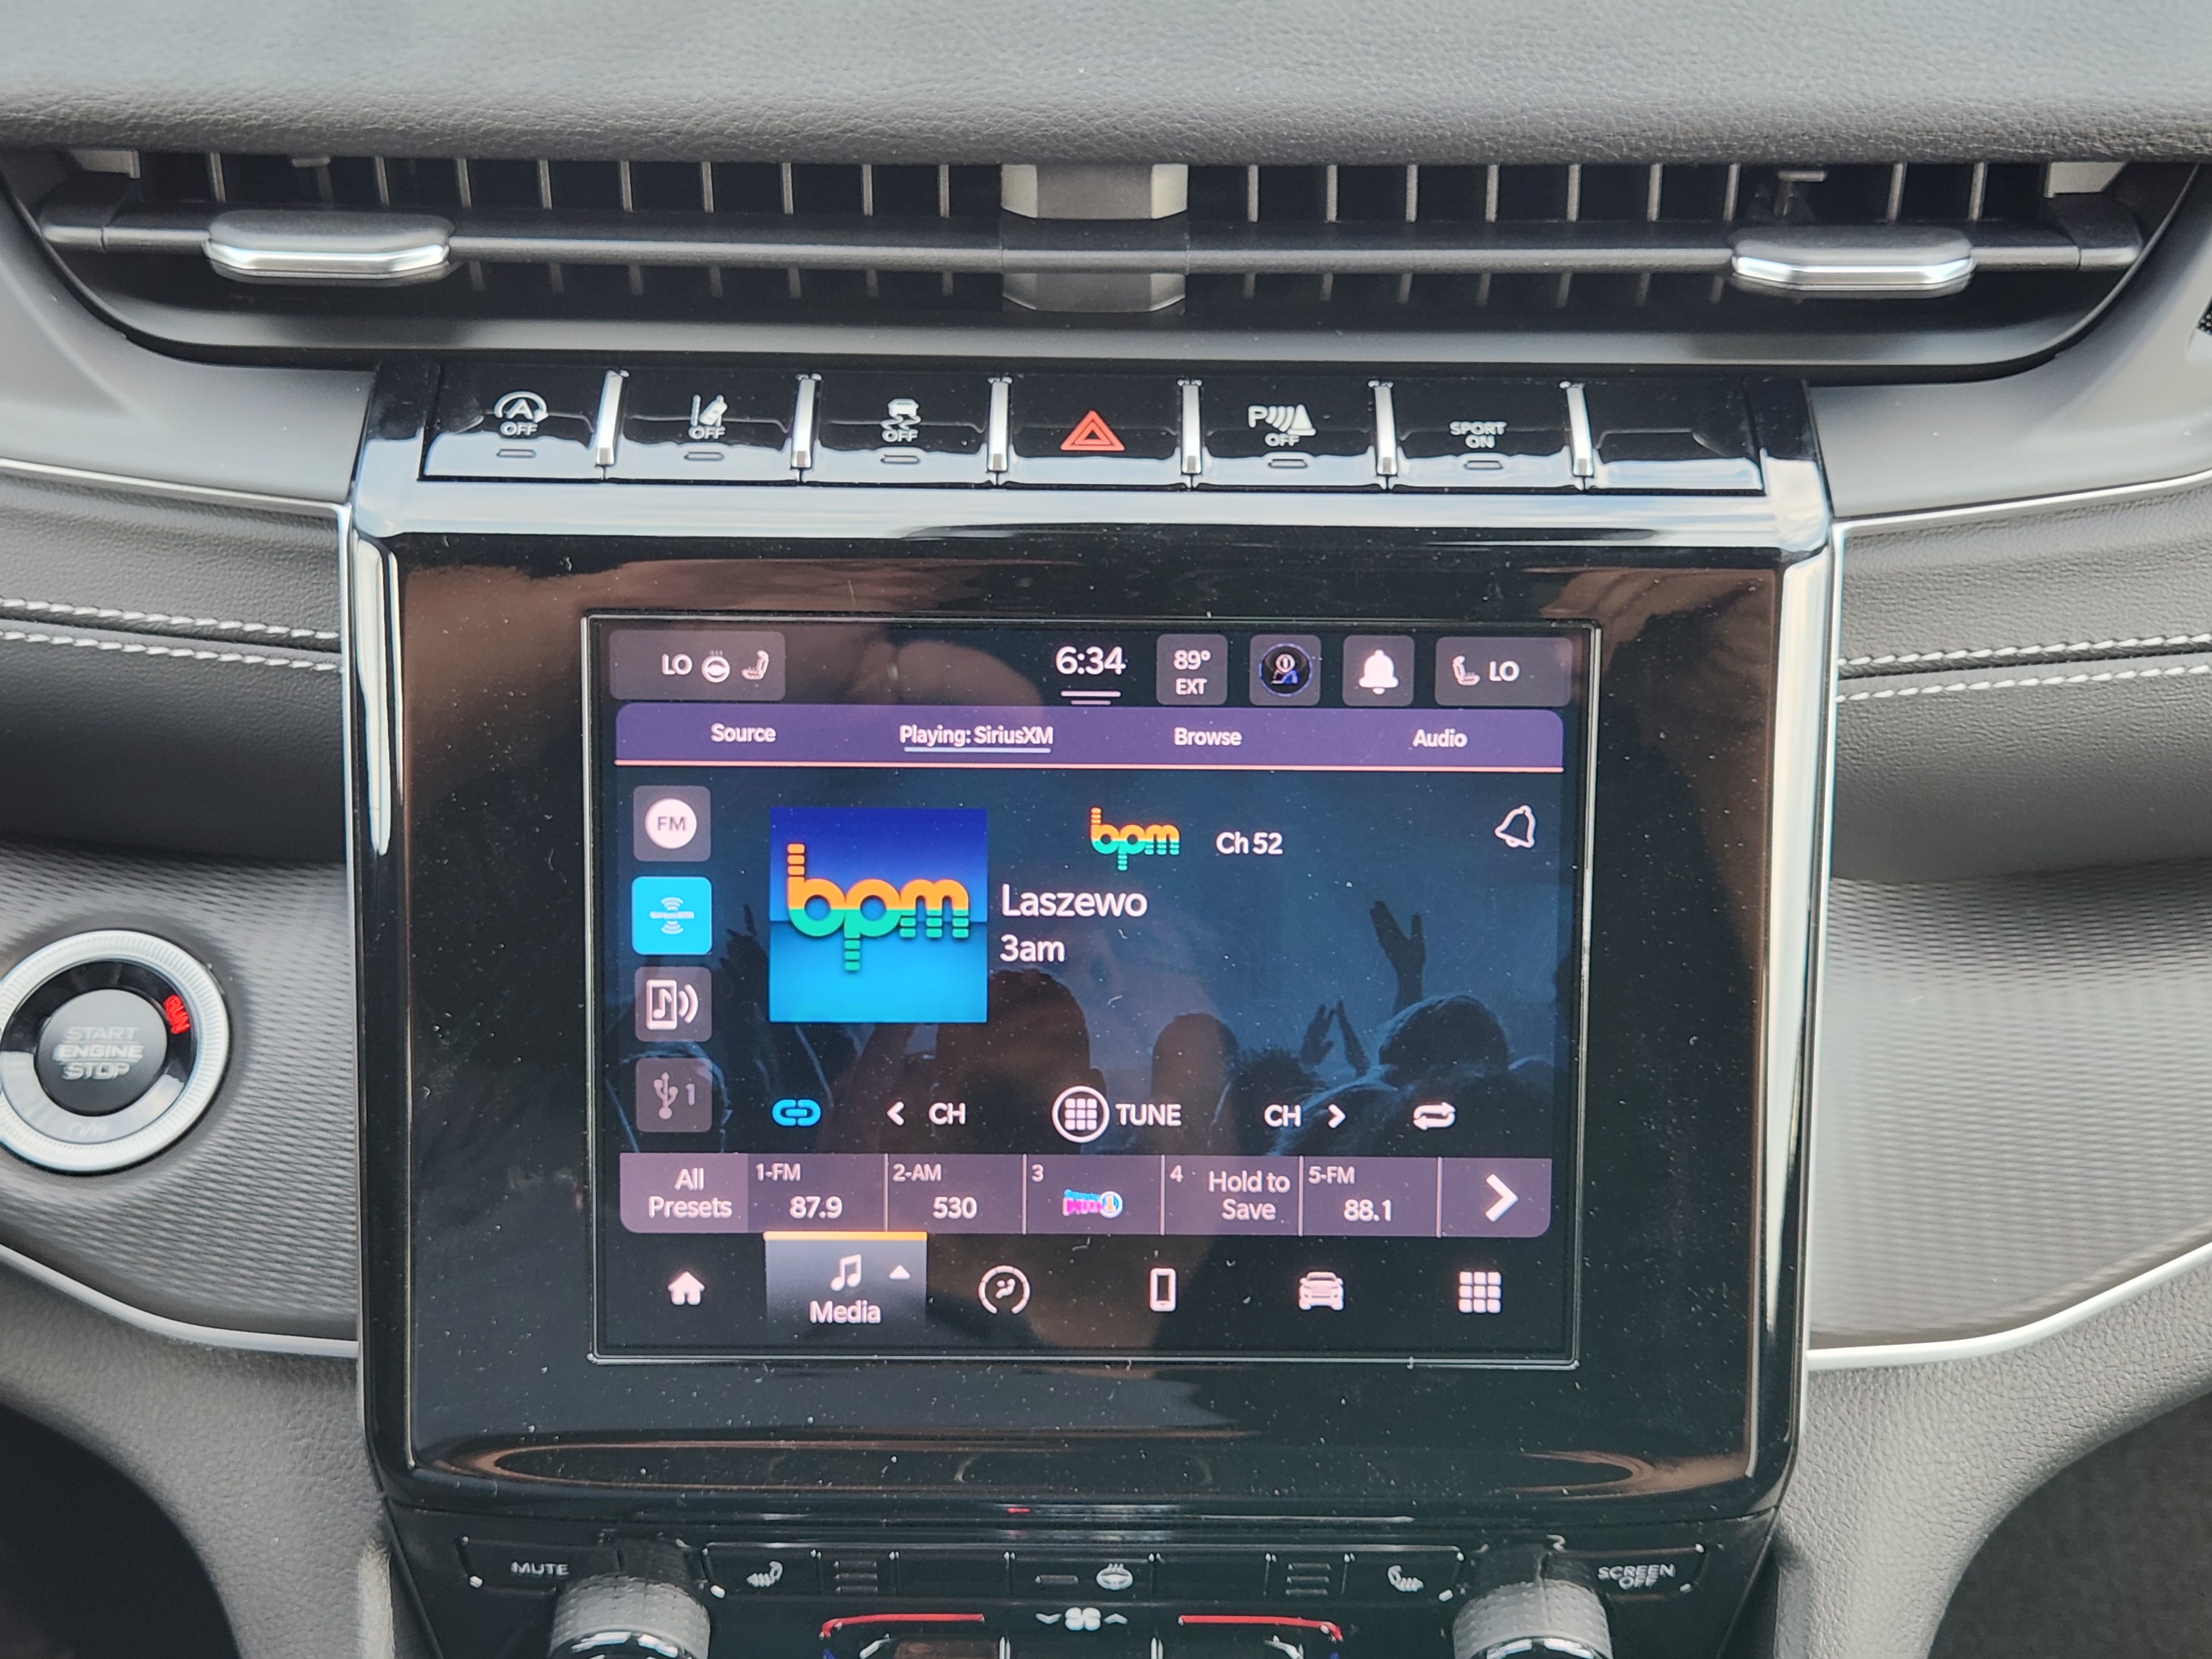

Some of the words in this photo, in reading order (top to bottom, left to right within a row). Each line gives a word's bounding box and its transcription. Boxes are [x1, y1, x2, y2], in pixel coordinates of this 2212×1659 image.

[507, 398, 534, 419] A
[500, 421, 538, 436] OFF
[688, 427, 725, 440] OFF
[882, 427, 918, 443] OFF
[1449, 421, 1507, 436] SPORT
[1265, 433, 1301, 446] OFF
[1465, 435, 1495, 448] ON
[662, 654, 693, 675] LO
[1055, 646, 1127, 676] 6:34
[1489, 661, 1520, 682] LO
[1176, 678, 1207, 696] EXT
[711, 723, 776, 743] Source
[900, 724, 971, 747] Playing:
[973, 725, 1053, 745] SiriusXM
[1174, 727, 1242, 746] Browse
[1413, 729, 1468, 748] Audio
[658, 816, 686, 831] FM
[1090, 806, 1180, 872] bpm
[1216, 831, 1249, 855] Ch
[1252, 831, 1284, 855] 52
[787, 843, 969, 972] bpm
[1001, 883, 1148, 917] Laszewo
[1000, 935, 1065, 962] 3am
[164, 994, 190, 1034] RUN
[65, 1027, 140, 1040] START
[54, 1045, 144, 1061] ENGINE
[62, 1062, 131, 1080] STOP
[686, 1083, 695, 1105] 1
[928, 1102, 967, 1125] CH
[1115, 1103, 1182, 1126] TUNE
[1264, 1104, 1301, 1127] CH
[675, 1168, 705, 1191] All
[755, 1163, 801, 1182] 1-FM
[893, 1164, 942, 1182] 2-AM
[1031, 1165, 1044, 1182] 3
[1170, 1166, 1183, 1183] 4
[1208, 1170, 1262, 1193] Hold
[1266, 1172, 1291, 1193] to
[1308, 1166, 1355, 1185] 5-FM
[648, 1196, 733, 1218] Presets
[789, 1197, 843, 1219] 87.9
[933, 1197, 977, 1219] 530
[1221, 1199, 1276, 1220] Save
[1343, 1199, 1392, 1222] 88.1
[809, 1301, 881, 1324] Media
[511, 1561, 569, 1575] MUTE
[1598, 1564, 1676, 1580] SCREEN
[1618, 1575, 1657, 1590] OFF
